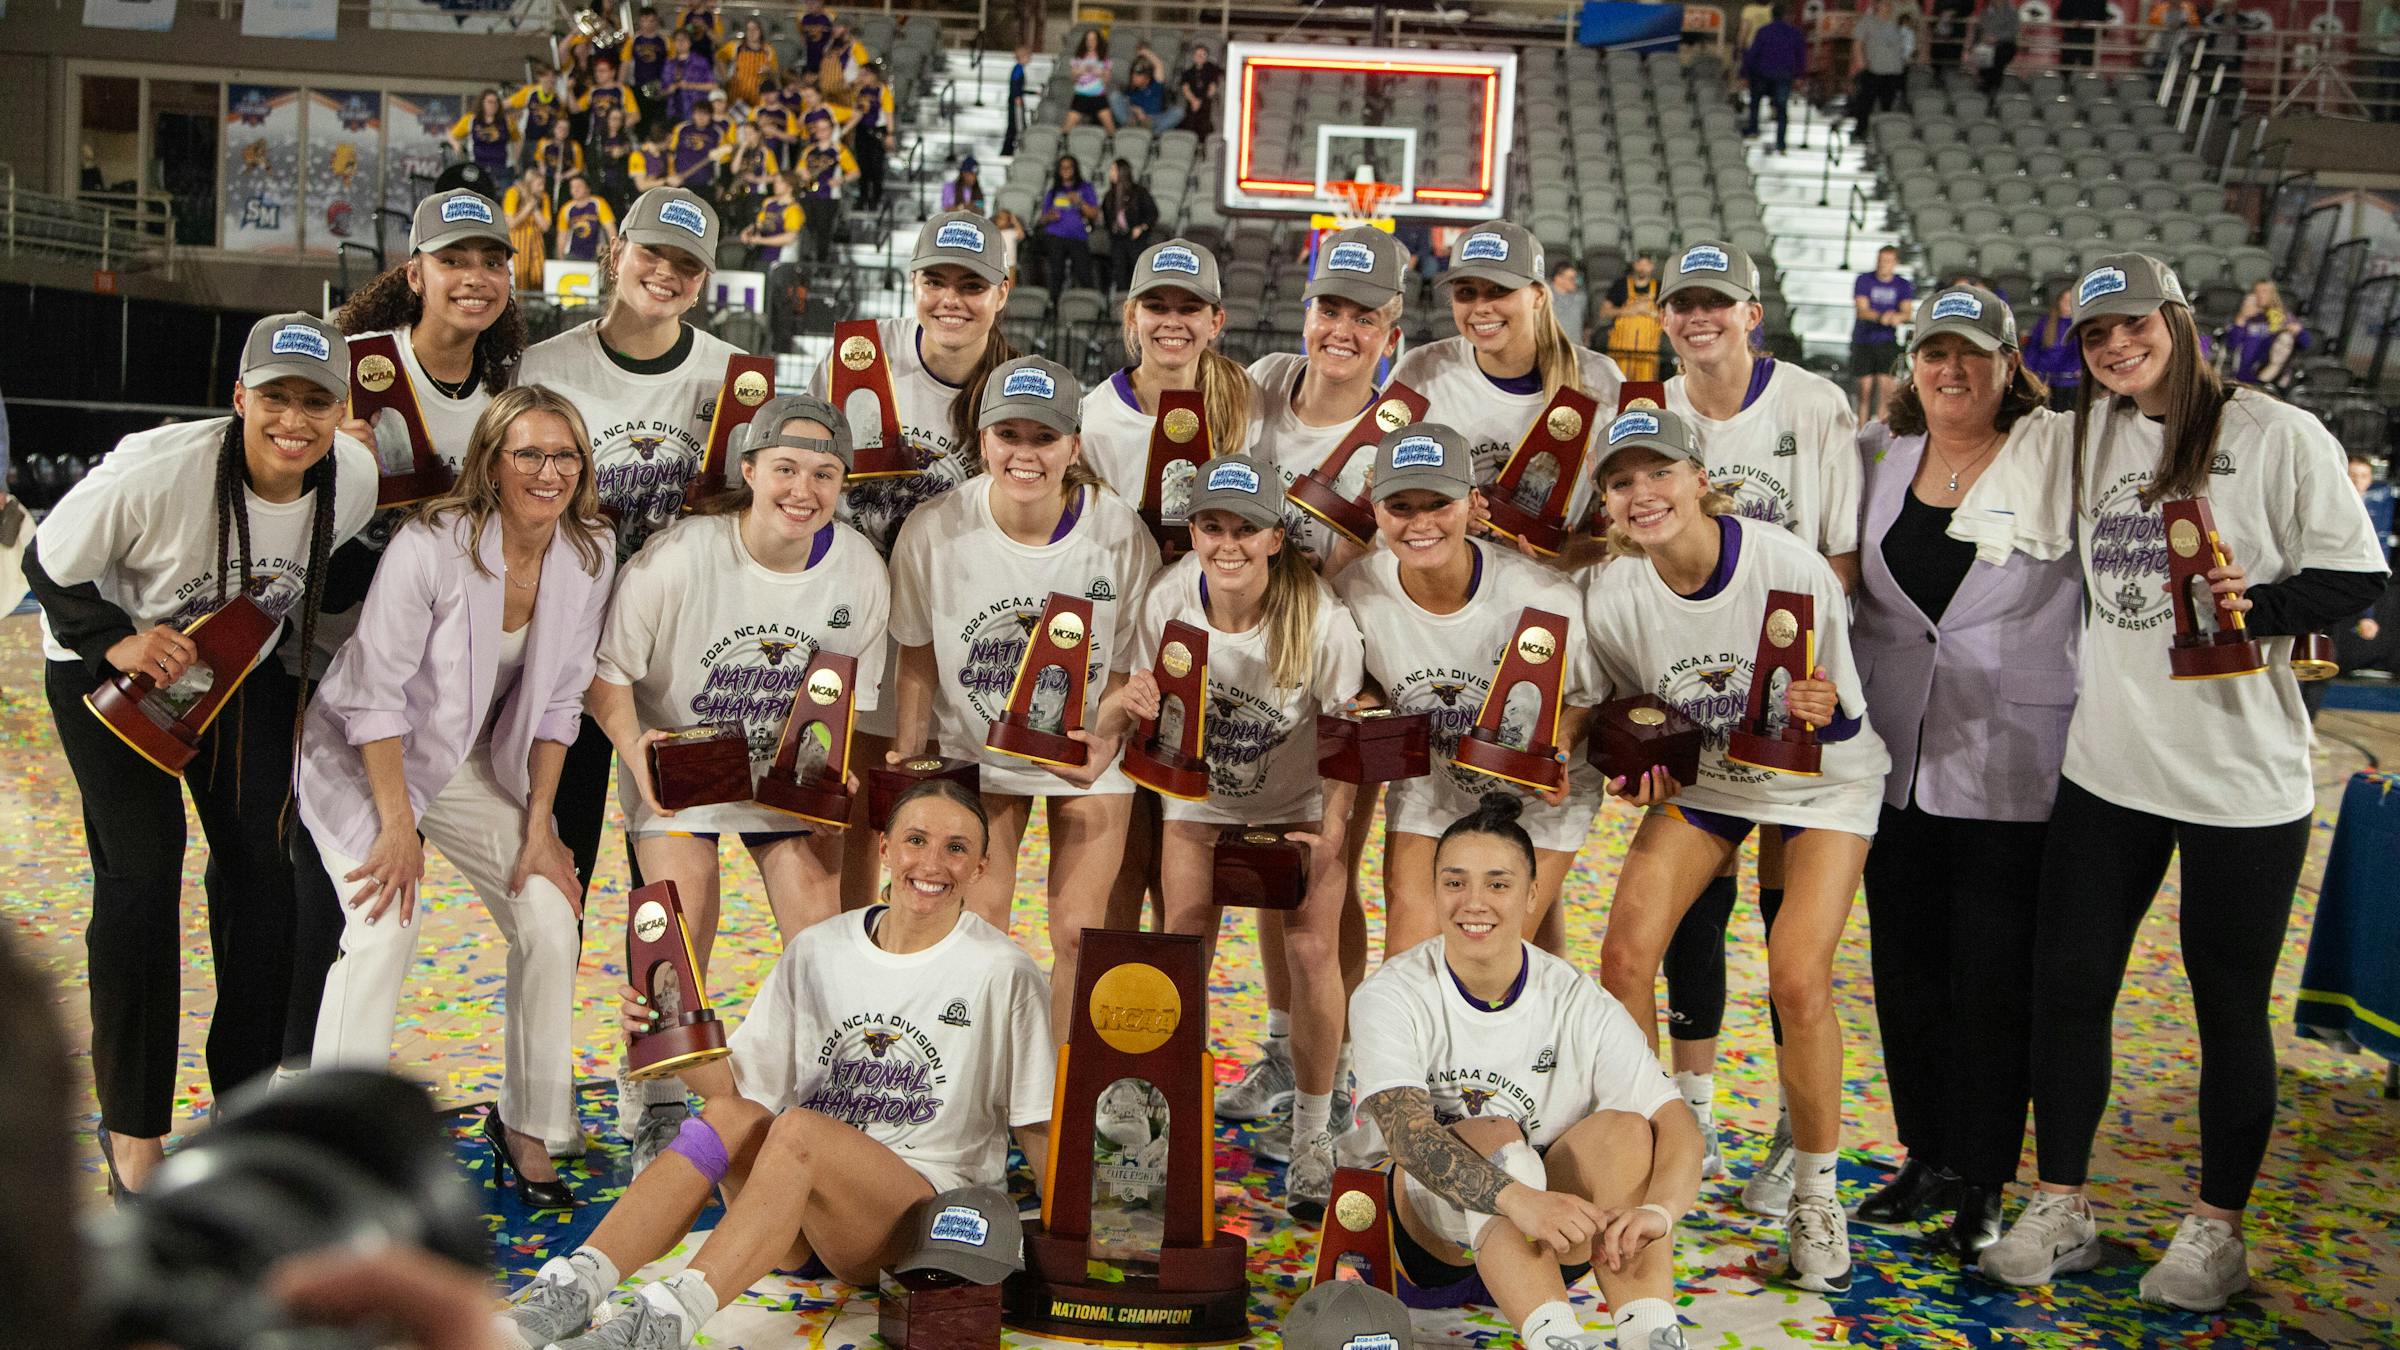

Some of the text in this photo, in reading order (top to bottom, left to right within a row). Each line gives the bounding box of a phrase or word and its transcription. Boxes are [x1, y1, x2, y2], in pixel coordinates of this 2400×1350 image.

[447, 201, 484, 212] NATIONAL
[445, 209, 491, 221] CHAMPIONS
[669, 206, 701, 223] NATIONAL
[661, 213, 704, 233] CHAMPIONS
[944, 228, 979, 241] NATIONAL
[938, 236, 981, 249] CHAMPIONS
[1468, 240, 1503, 251] NATIONAL
[1159, 251, 1193, 263] NATIONAL
[1334, 249, 1367, 262] NATIONAL
[1464, 246, 1505, 258] CHAMPIONS
[1687, 252, 1722, 263] NATIONAL
[1154, 259, 1197, 271] CHAMPIONS
[1330, 257, 1372, 269] CHAMPIONS
[1682, 258, 1725, 269] CHAMPIONS
[1934, 305, 1978, 317] CHAMPIONS
[1939, 298, 1975, 310] NATIONAL
[279, 331, 323, 346] NATIONAL
[275, 342, 328, 356] CHAMPIONS
[844, 351, 874, 361] NCAA
[362, 371, 393, 383] NCAA
[1010, 374, 1048, 388] NATIONAL
[737, 388, 767, 398] NCAA
[1005, 384, 1051, 396] CHAMPIONS
[1378, 410, 1407, 427] NCAA
[1614, 418, 1652, 432] NATIONAL
[603, 420, 705, 461] NCAA DIVISION
[1610, 425, 1657, 441] CHAMPIONS
[902, 426, 976, 480] CAA DIVISIO
[1399, 443, 1435, 456] NATIONAL
[1470, 442, 1511, 457] NCAA
[1781, 440, 1794, 451] 50
[1394, 452, 1442, 465] CHAMPIONS
[2212, 457, 2228, 469] 50
[1214, 469, 1253, 483] NATIONAL
[1708, 466, 1728, 480] AA
[1732, 464, 1788, 500] DIVISION
[1210, 478, 1256, 490] CHAMPIONS
[2091, 486, 2118, 518] 2024
[2092, 511, 2166, 549] NATION
[2093, 544, 2170, 580] HAMPIO
[175, 571, 213, 600] 2024
[272, 557, 309, 584] DIVISI
[1095, 585, 1110, 595] 50
[836, 611, 849, 624] 50
[960, 596, 1034, 644] 2024 NCAA
[2117, 608, 2173, 631] BASKETB
[1053, 628, 1081, 641] NCAA
[700, 636, 732, 669] 2024
[734, 623, 779, 641] NCAA
[967, 637, 1028, 668] NATI
[1520, 642, 1551, 657] NCAA
[1670, 654, 1713, 676] NCAA
[1720, 653, 1756, 673] DIVIS
[703, 664, 807, 696] NATION
[1405, 668, 1445, 685] NCAA
[1451, 669, 1490, 691] DIVIS
[810, 684, 840, 698] NCAA
[690, 693, 796, 725] CHAMPI
[1230, 686, 1286, 723] DIVISION
[1217, 766, 1269, 799] BASKETB
[1699, 769, 1777, 784] EN'S BASKET
[637, 917, 665, 933] NCAA
[950, 1011, 965, 1020] 50
[1097, 1004, 1177, 1035] NCAA
[818, 1012, 946, 1085] 2024 NCAA DIVISION II
[800, 1086, 943, 1127] HAMPIONS
[1440, 1068, 1481, 1083] NCAA
[1486, 1071, 1538, 1119] DIVISION
[1530, 1119, 1541, 1130] II
[941, 1215, 981, 1231] NATIONAL
[932, 1226, 985, 1241] CHAMPIONS
[1051, 1301, 1192, 1324] NATIONAL CHAMPION
